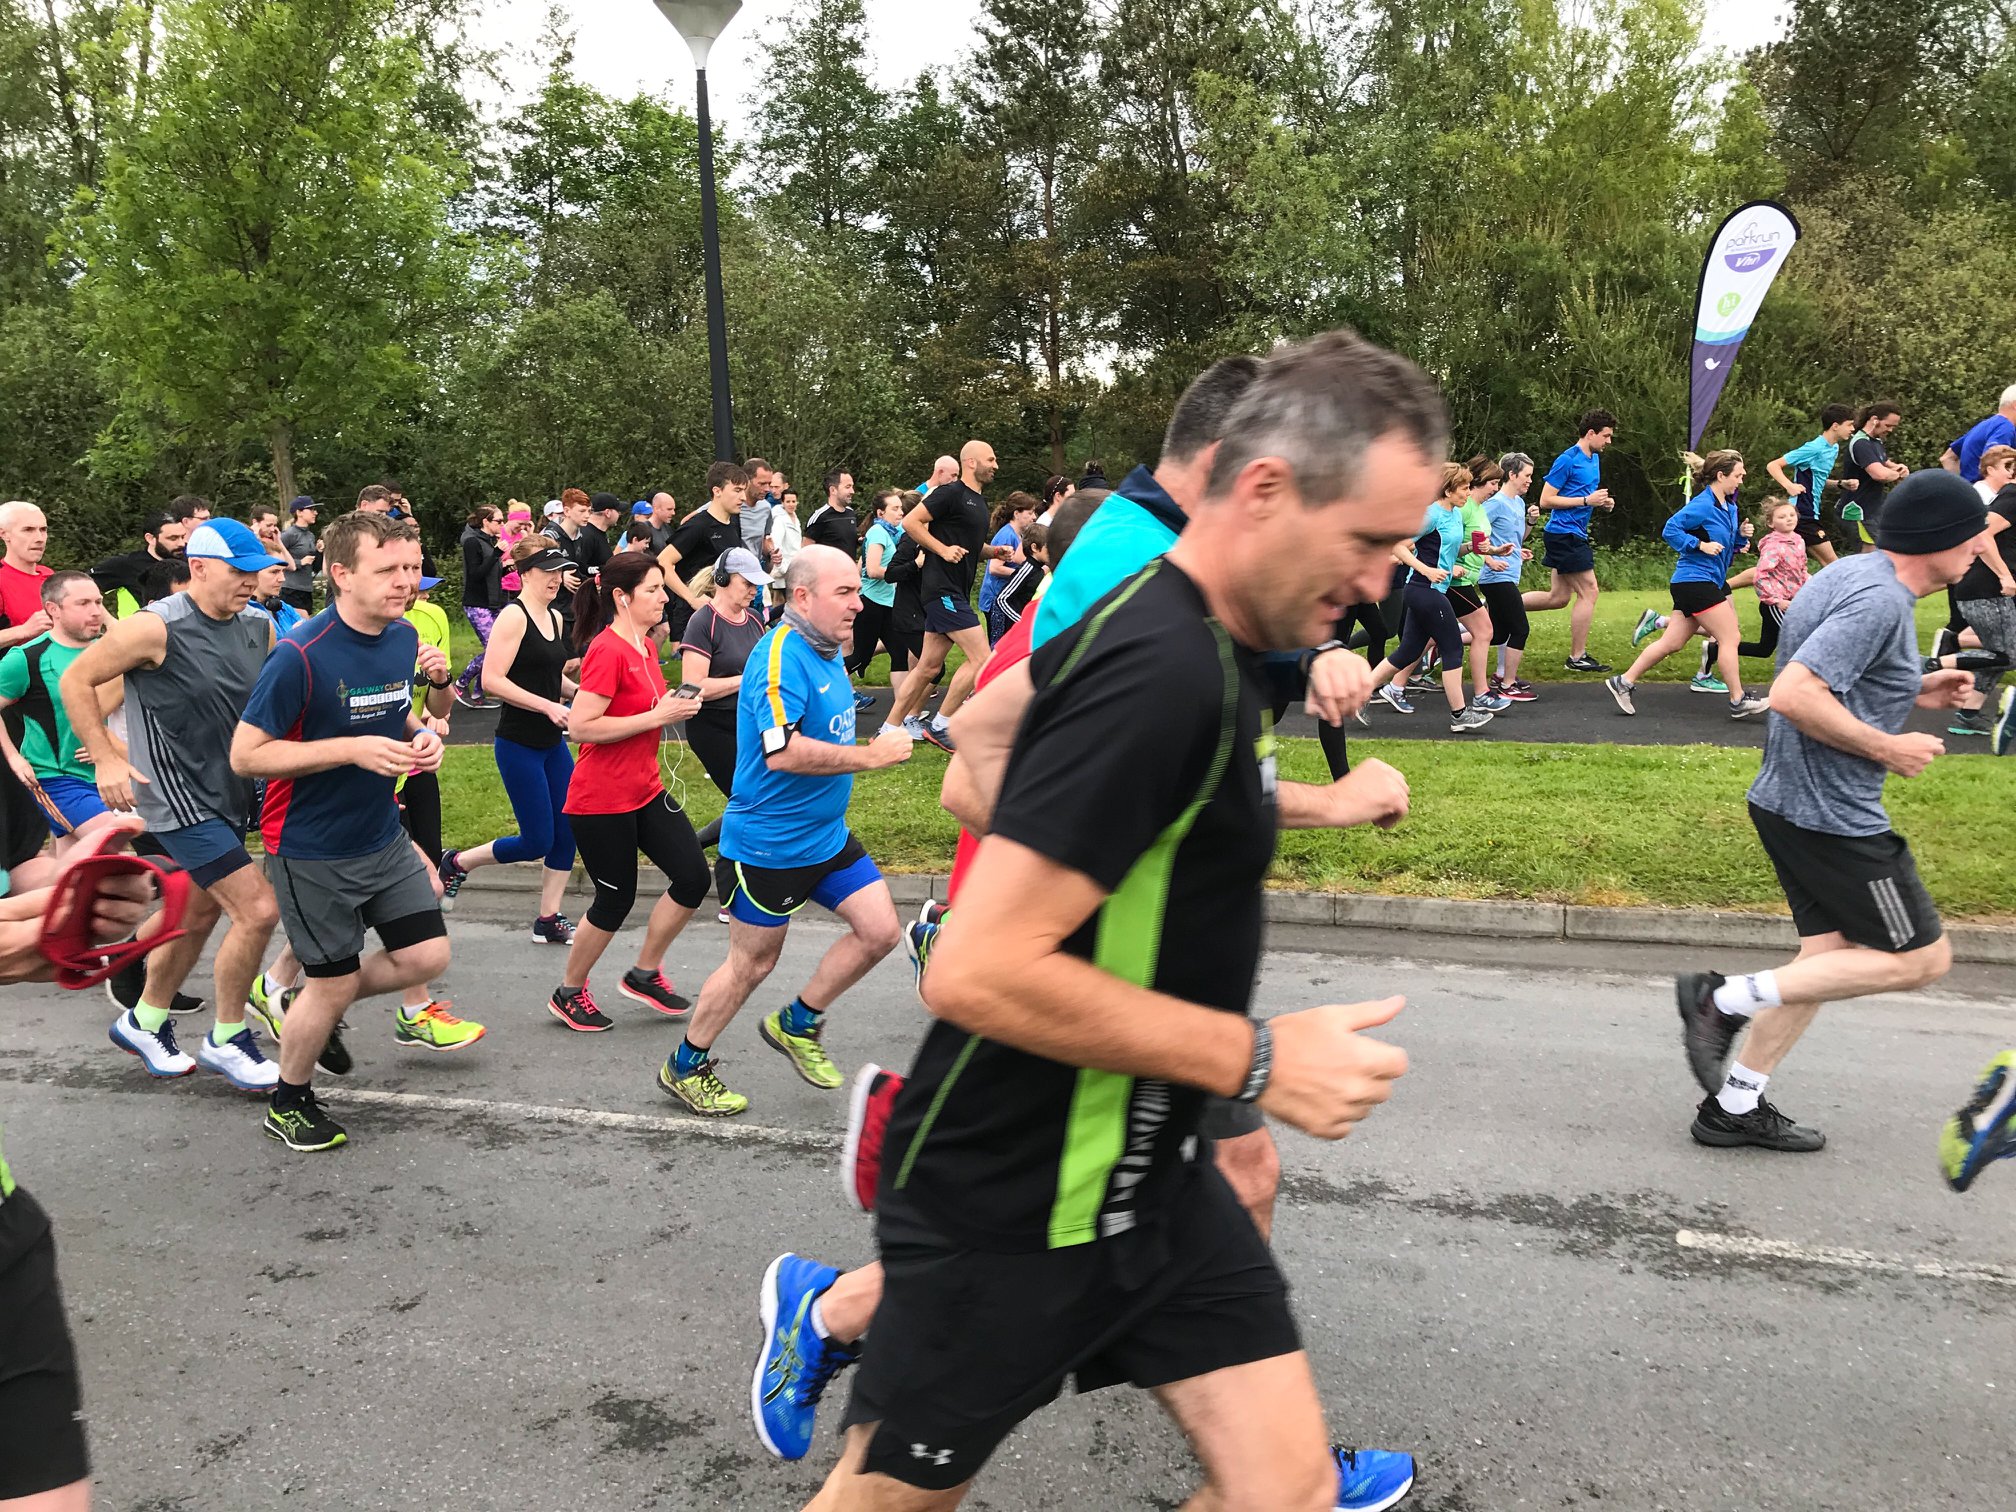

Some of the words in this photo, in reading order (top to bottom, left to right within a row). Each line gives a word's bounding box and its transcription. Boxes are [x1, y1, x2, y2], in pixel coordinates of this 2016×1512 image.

[1725, 223, 1780, 251] parkrun
[350, 685, 384, 695] GALWAY
[385, 681, 404, 691] CLINIC
[352, 690, 405, 706] STREETS
